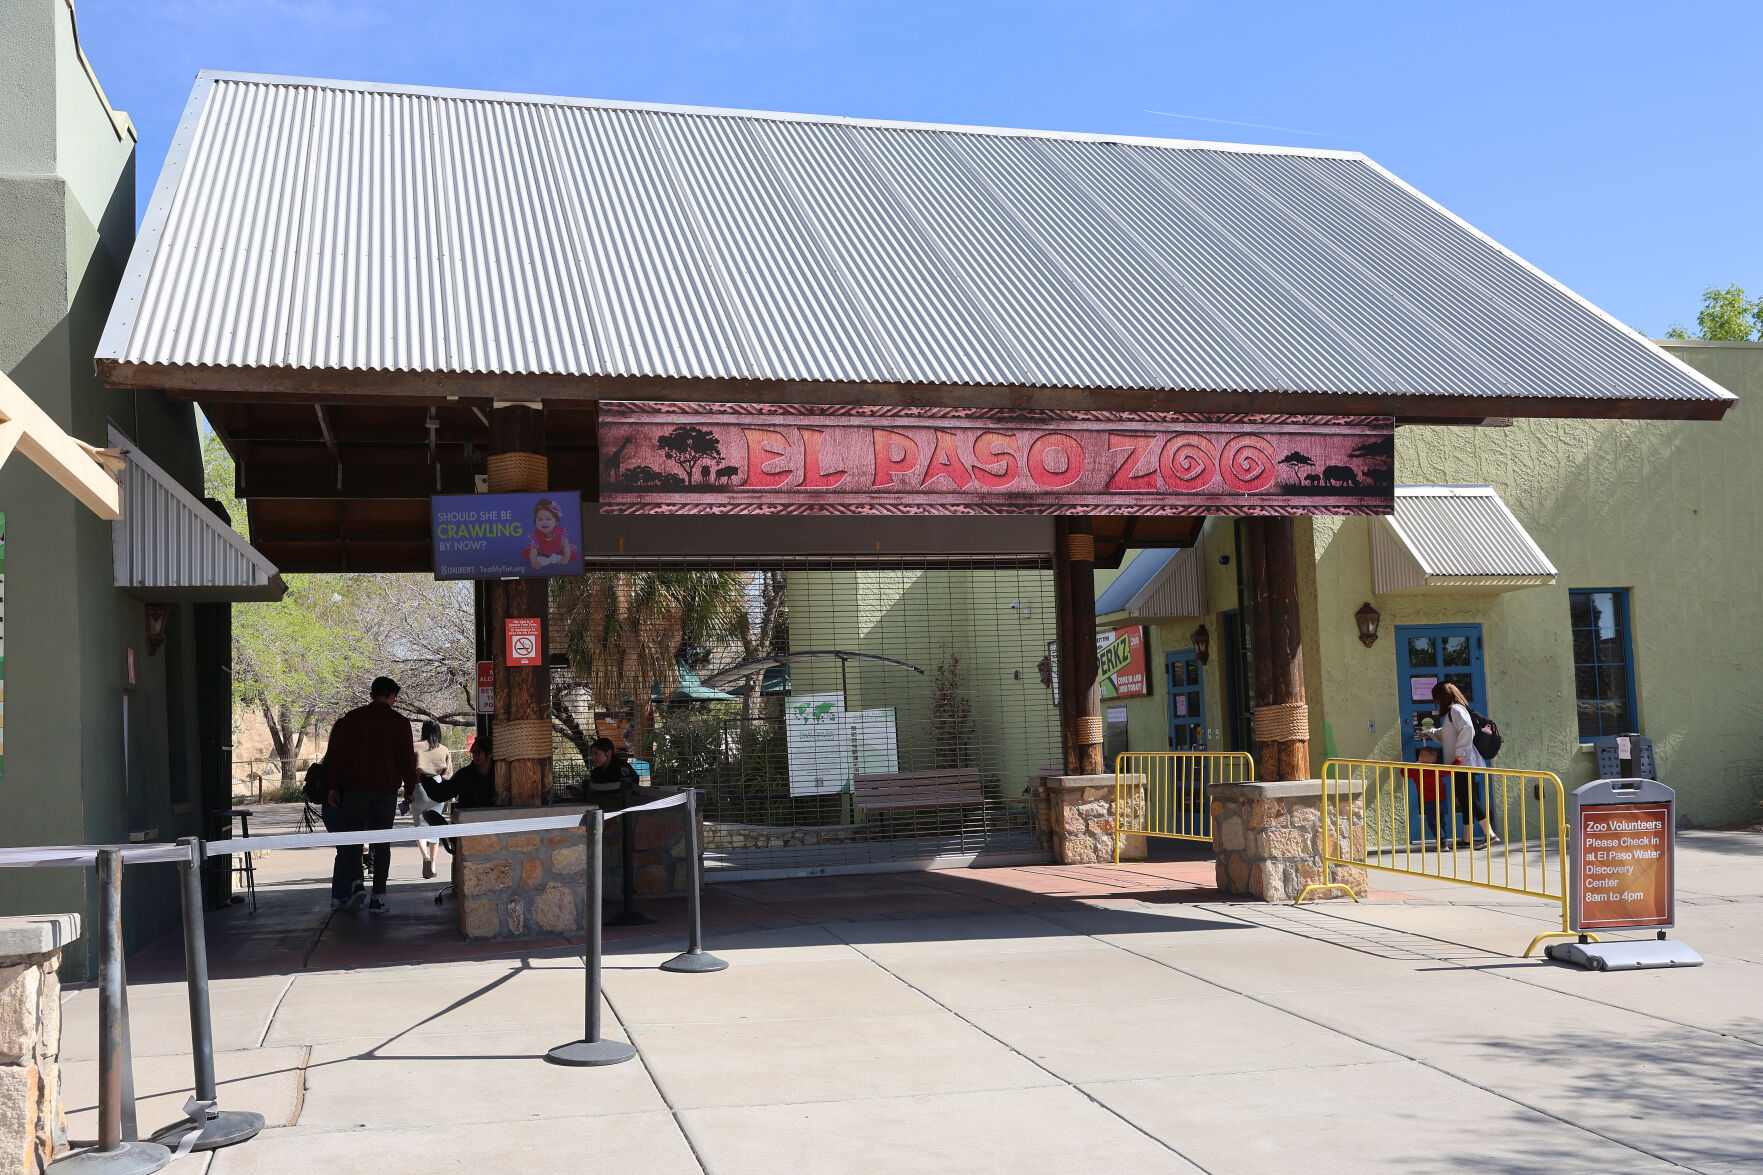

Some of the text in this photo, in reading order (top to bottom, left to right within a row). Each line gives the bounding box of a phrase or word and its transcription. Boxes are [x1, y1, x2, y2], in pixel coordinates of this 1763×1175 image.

[740, 427, 1277, 493] EL PASO ZOO
[438, 510, 512, 521] SHOULD SHE BE
[438, 522, 523, 538] CRAWLING
[439, 541, 486, 551] BY NOW?
[1097, 637, 1129, 676] ERKZ
[1586, 820, 1662, 831] Zoo Volunteers
[1586, 836, 1660, 847] Please Check in
[1586, 850, 1660, 861] at El Paso Water
[1586, 865, 1634, 875] Discovery
[1586, 878, 1619, 887] Center
[1586, 891, 1644, 902] 8am to 4pm
